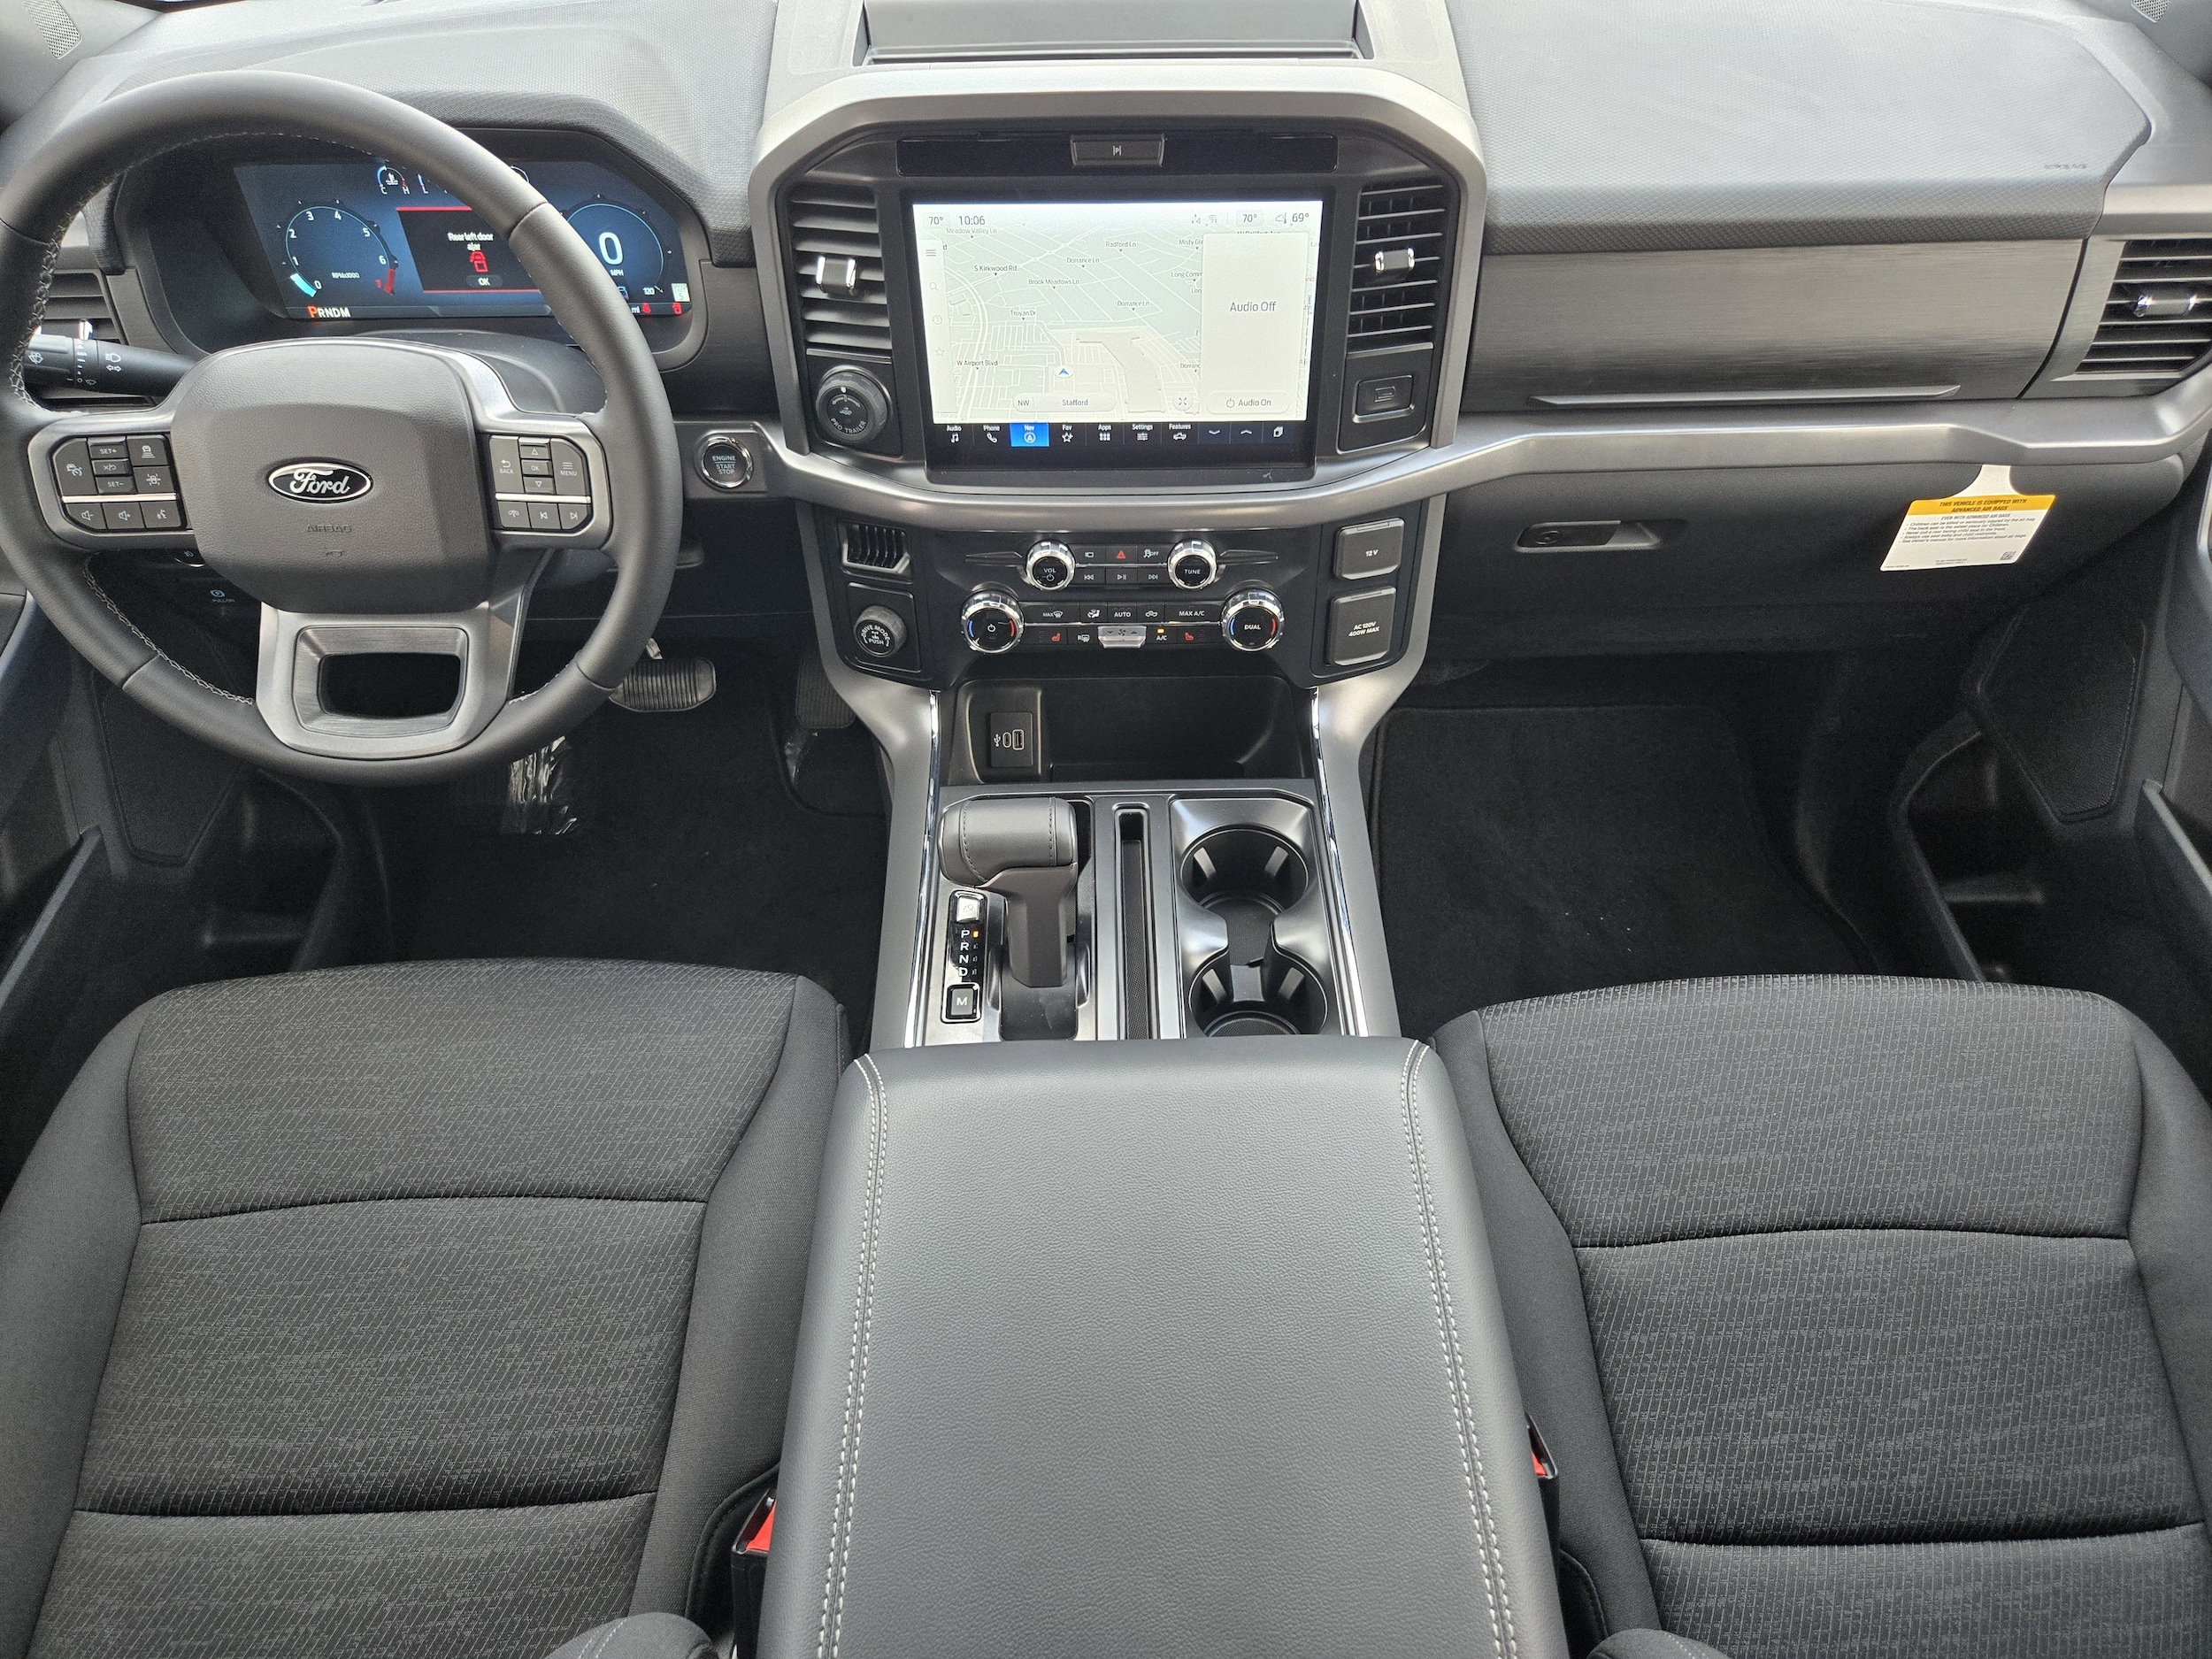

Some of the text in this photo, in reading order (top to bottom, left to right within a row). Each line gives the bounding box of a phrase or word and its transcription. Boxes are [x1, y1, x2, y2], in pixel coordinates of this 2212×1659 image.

[306, 211, 314, 220] 3
[334, 211, 342, 220] 4
[1242, 213, 1257, 223] 70°
[1292, 213, 1310, 222] 69°
[928, 216, 944, 226] 70°
[958, 215, 986, 226] 10:06
[289, 229, 296, 238] 2
[363, 228, 371, 237] 5
[477, 232, 493, 241] door
[599, 232, 623, 265] 0
[293, 257, 299, 265] 1
[379, 256, 387, 265] 6
[314, 280, 322, 289] 0
[643, 287, 655, 296] 120
[1230, 302, 1277, 312] Audio Off
[831, 418, 866, 434] PRO TRAILER
[289, 468, 350, 495] Ford
[861, 625, 890, 641] DRIVE MODE
[961, 930, 970, 939] P
[960, 942, 969, 951] R
[959, 955, 969, 964] N
